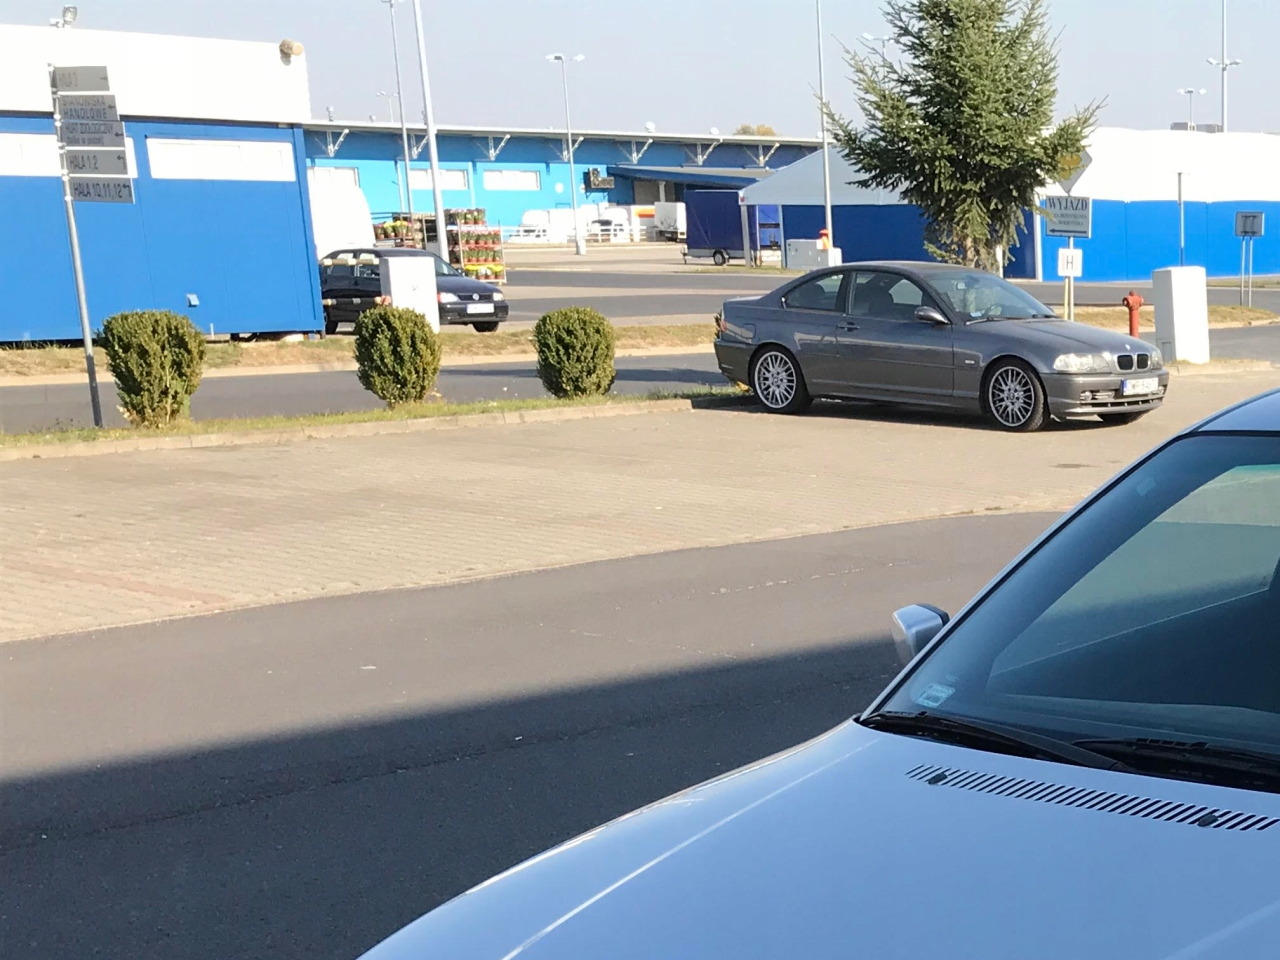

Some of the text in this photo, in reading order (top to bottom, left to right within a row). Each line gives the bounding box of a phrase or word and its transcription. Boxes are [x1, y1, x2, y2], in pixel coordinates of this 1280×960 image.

[63, 107, 108, 119] HANDLOWE
[69, 154, 86, 170] HALA
[73, 182, 91, 197] HALA
[1048, 198, 1088, 211] WYJAZD
